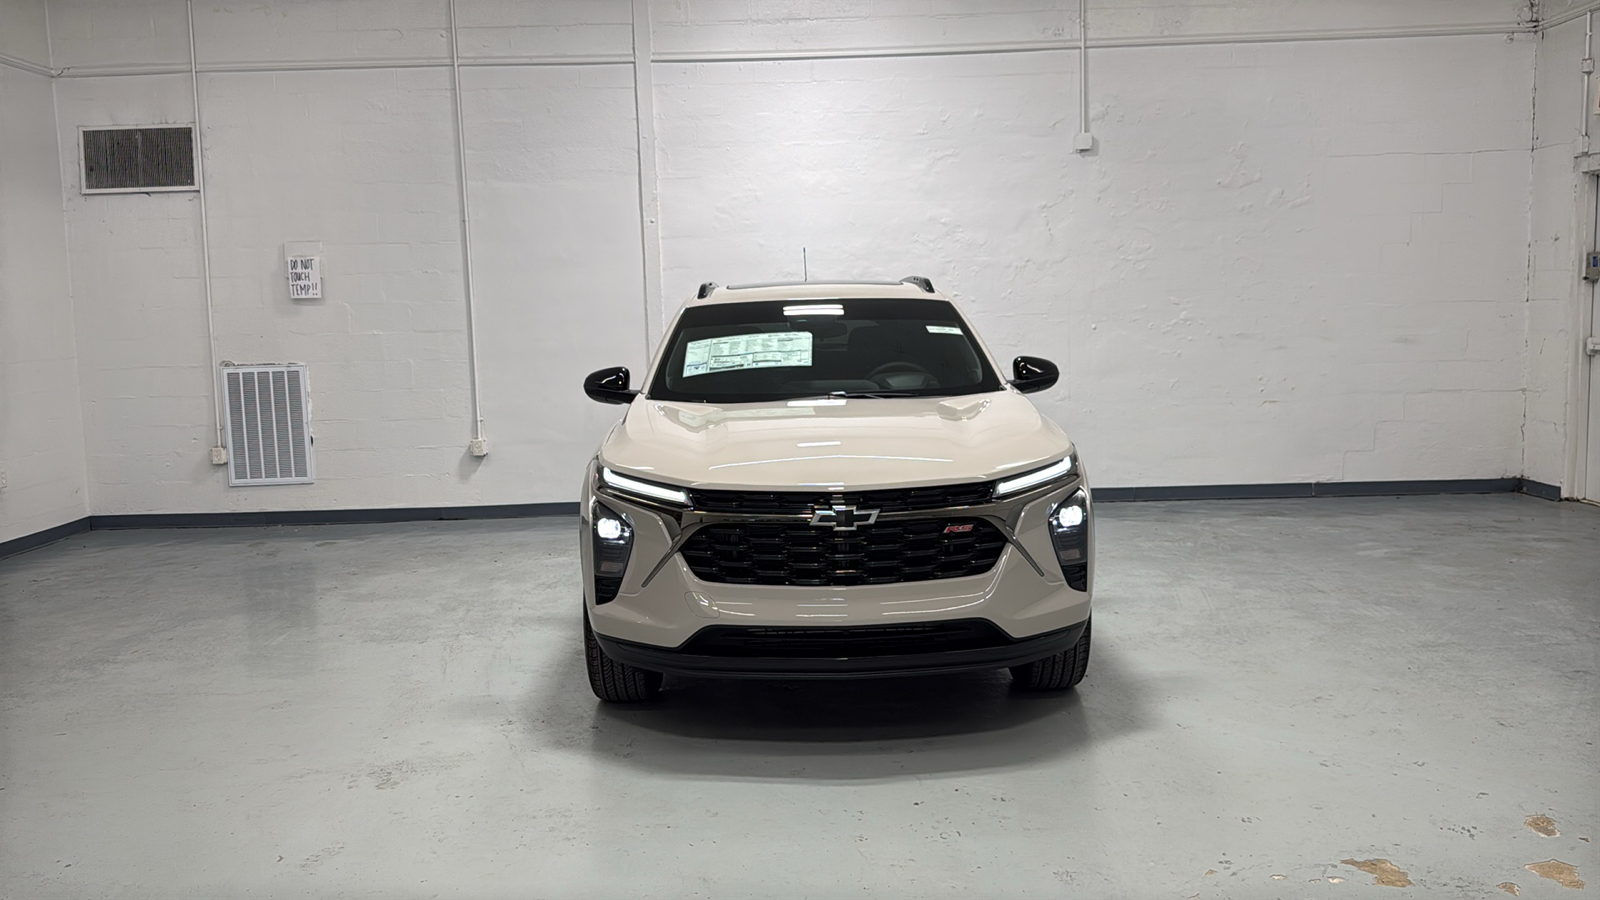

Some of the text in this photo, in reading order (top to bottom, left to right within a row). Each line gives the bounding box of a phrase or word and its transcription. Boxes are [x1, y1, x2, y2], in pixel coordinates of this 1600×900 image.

[290, 258, 315, 271] DO NOT
[290, 271, 310, 283] TOUCH
[291, 282, 318, 296] TEMP!!
[943, 524, 974, 533] RS
